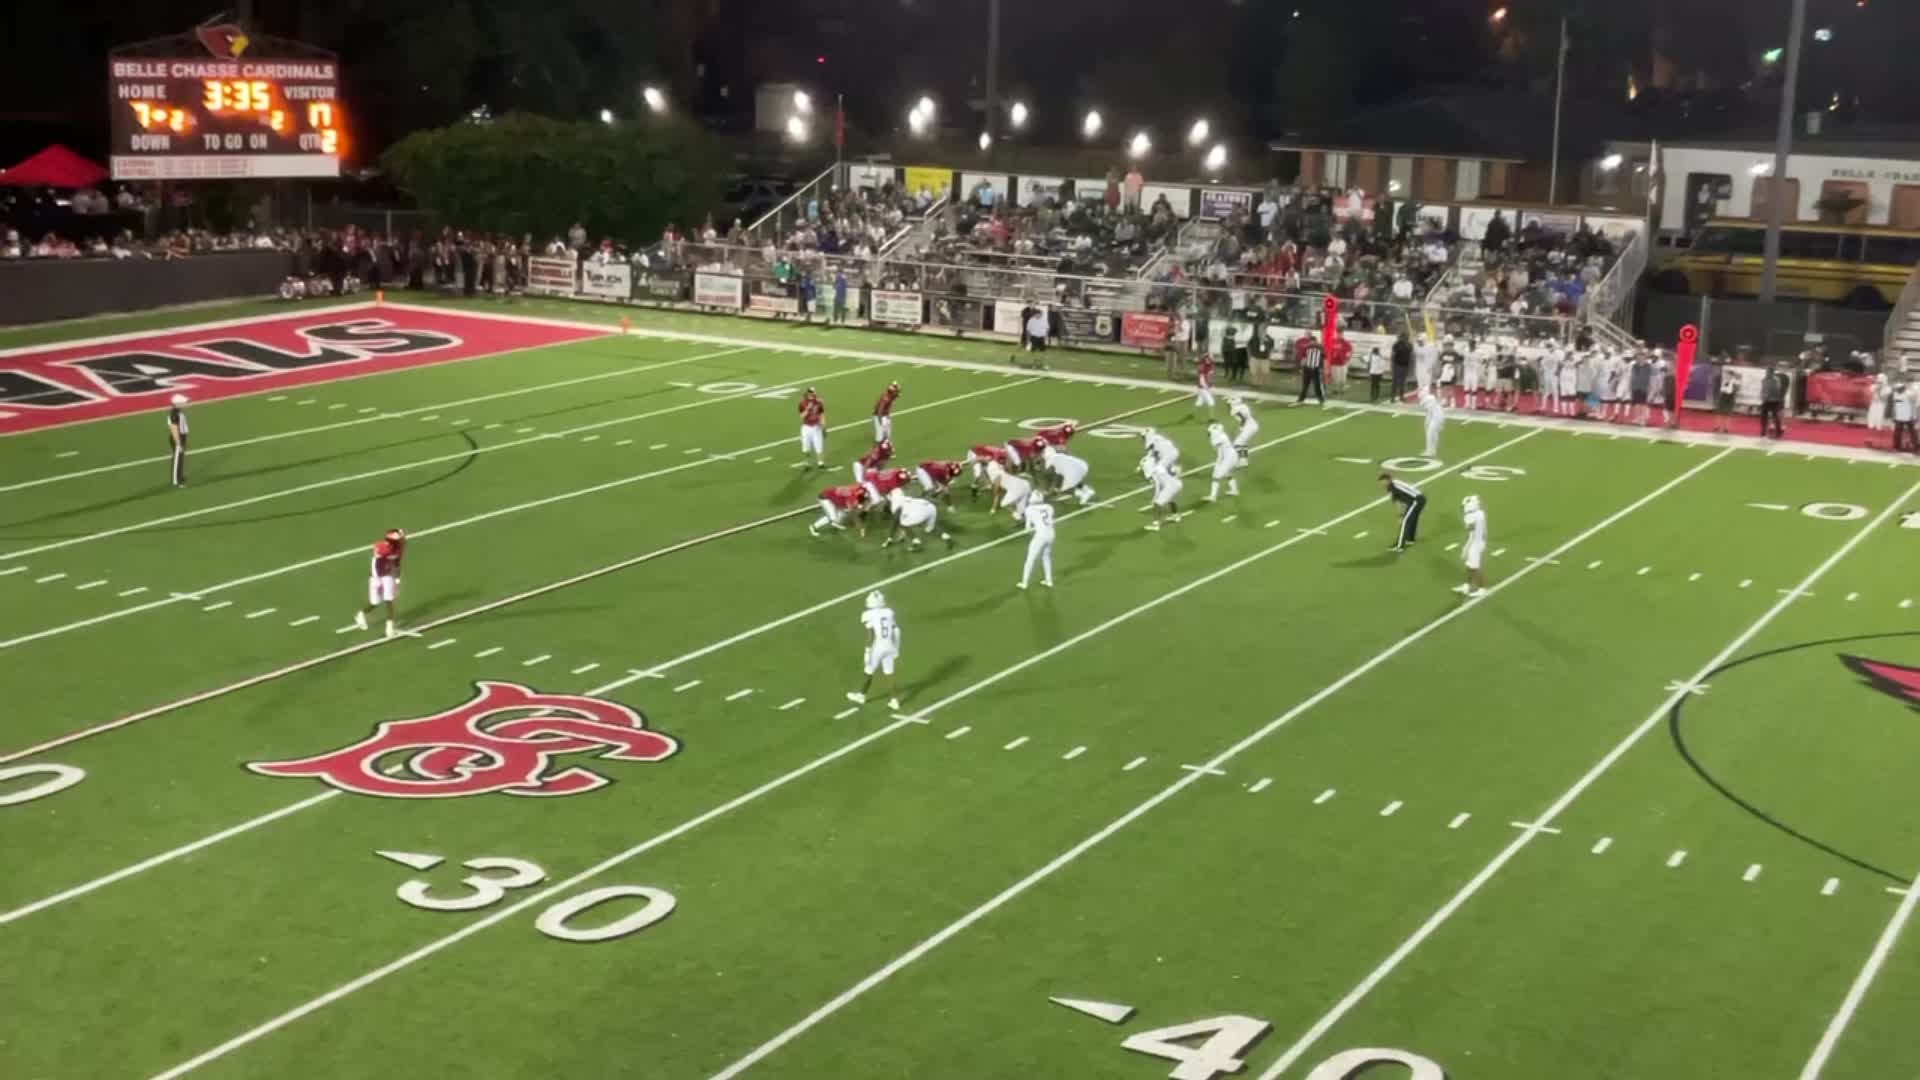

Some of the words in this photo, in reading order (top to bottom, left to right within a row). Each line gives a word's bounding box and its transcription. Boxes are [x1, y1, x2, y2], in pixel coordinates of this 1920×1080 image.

[113, 63, 167, 77] BELLE
[172, 63, 238, 78] CHASSE
[242, 64, 334, 79] CARDINALS
[118, 84, 167, 98] HOME
[203, 80, 270, 111] 3:35
[283, 86, 335, 99] VISITOR
[131, 135, 170, 150] DOWN
[204, 134, 219, 149] TO
[224, 134, 243, 149] GO
[250, 134, 267, 149] ON
[321, 130, 337, 154] 2
[396, 855, 678, 943] 30
